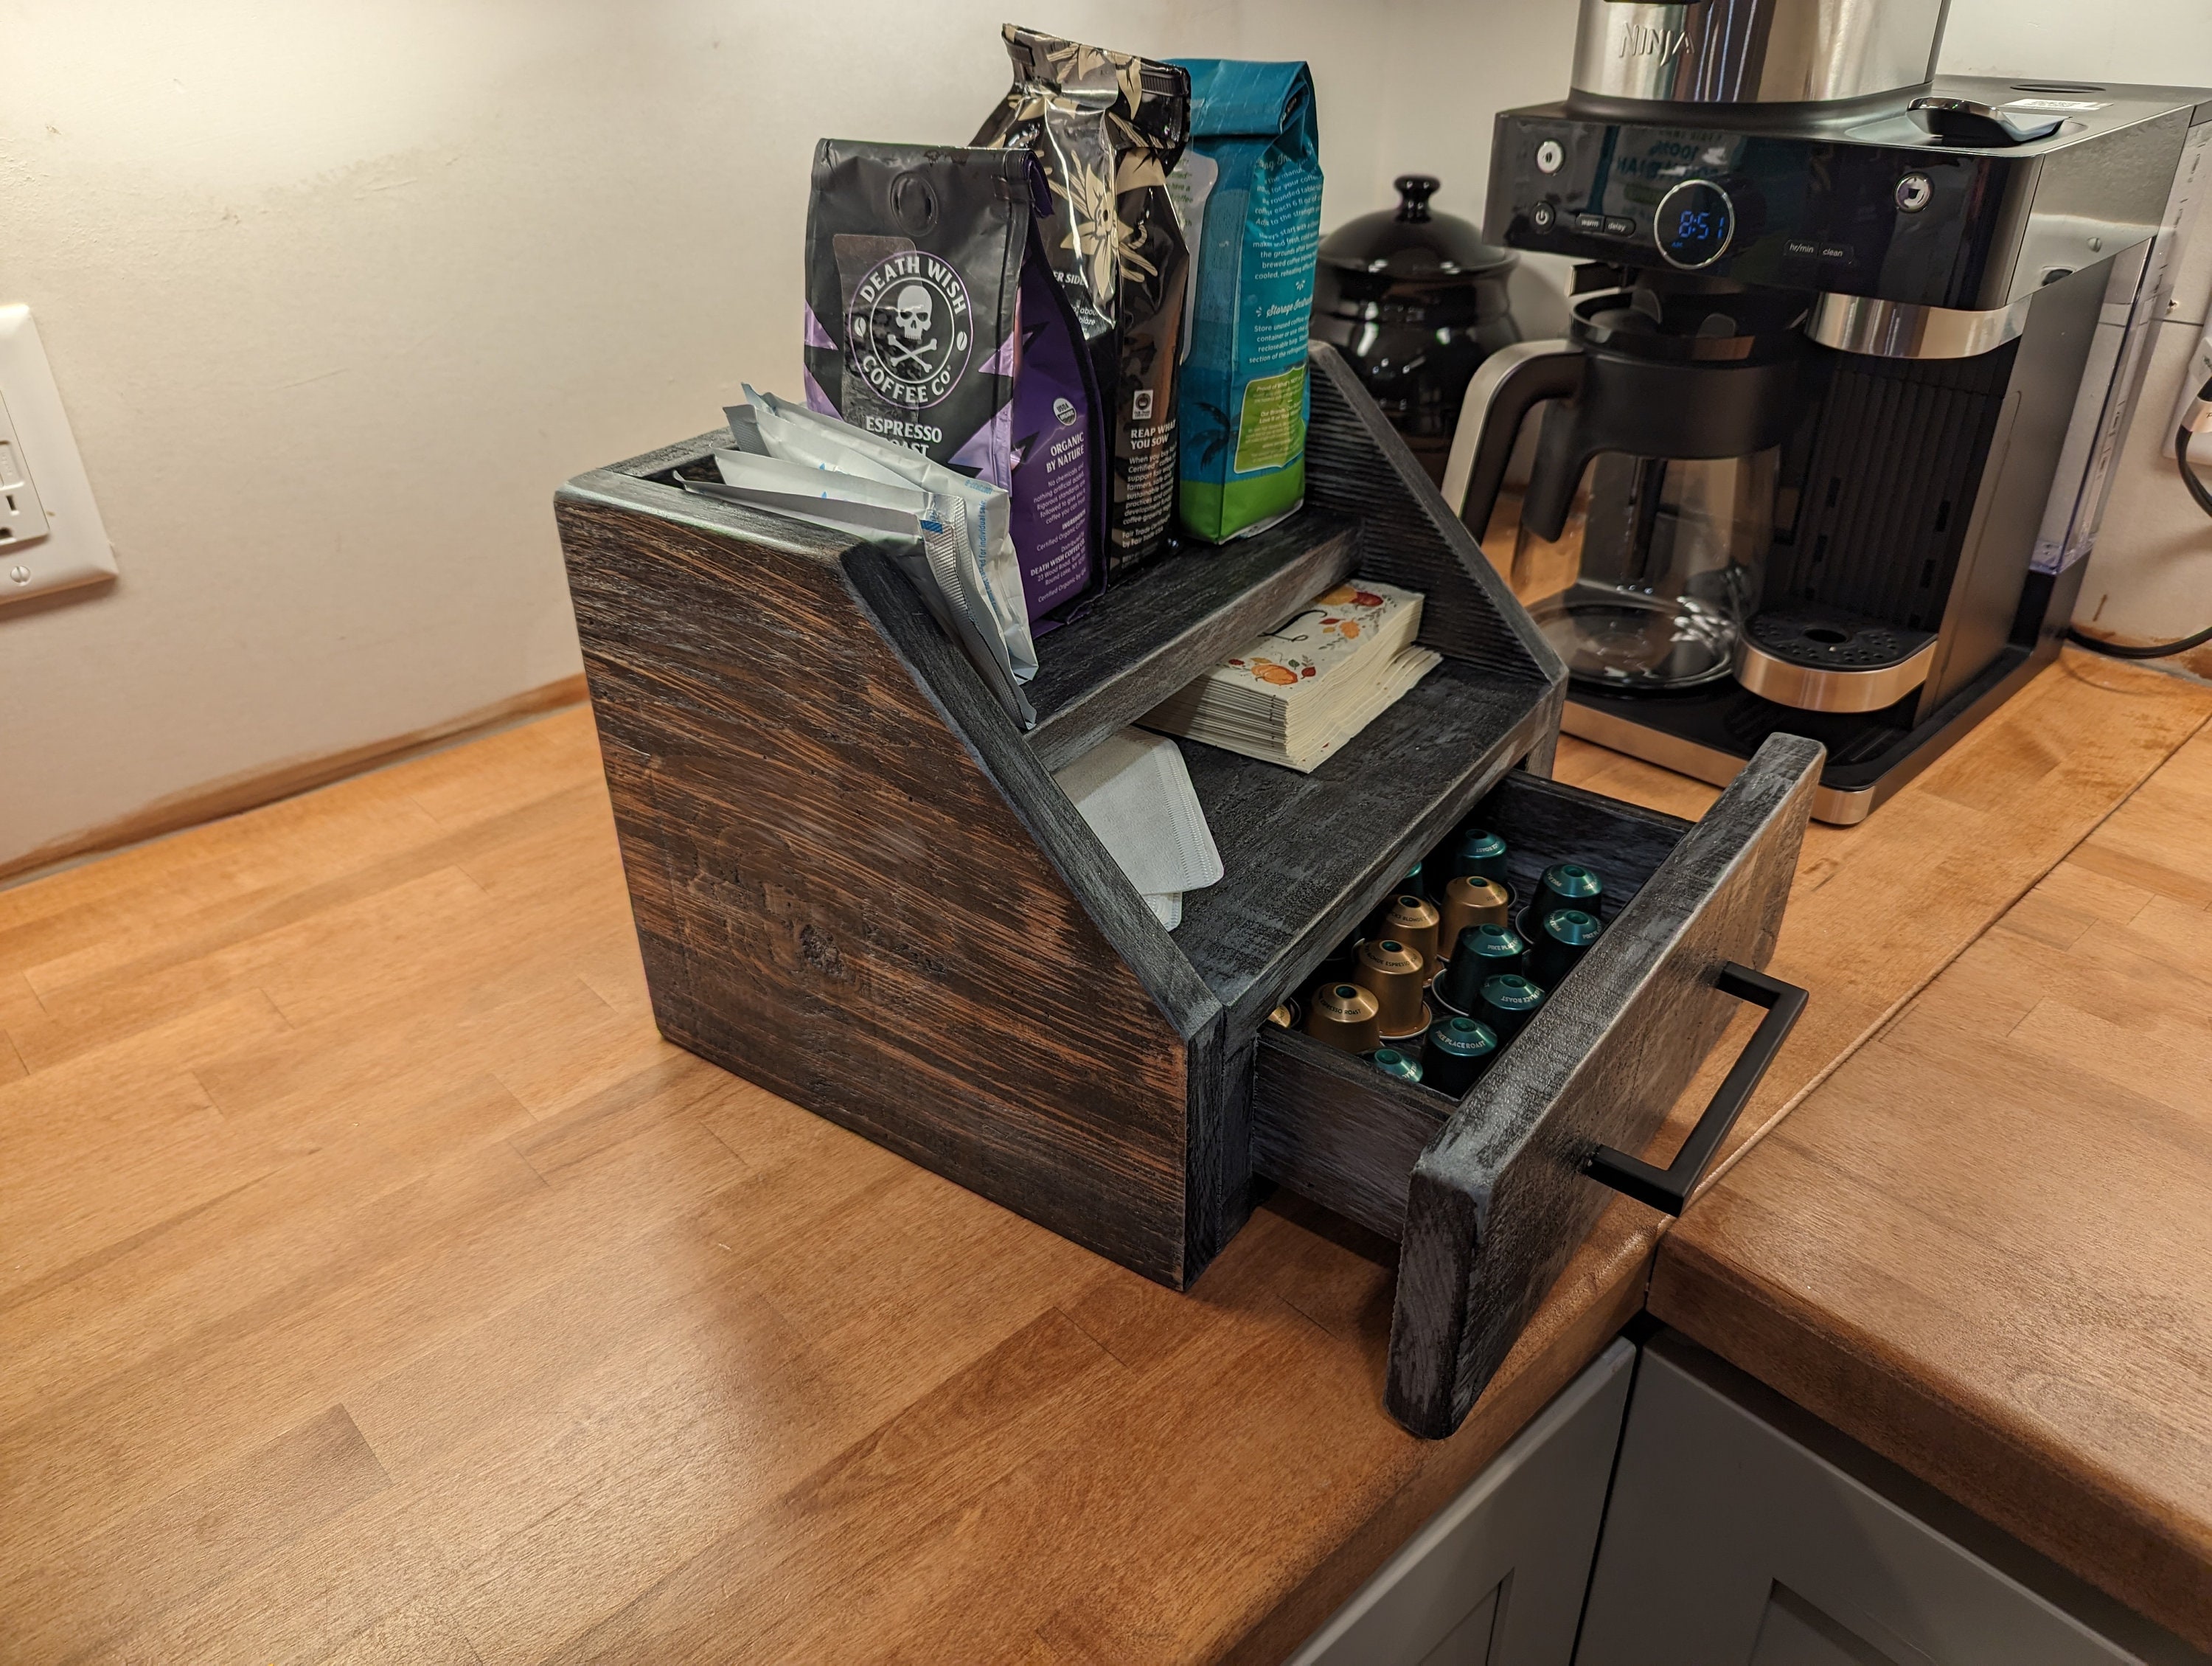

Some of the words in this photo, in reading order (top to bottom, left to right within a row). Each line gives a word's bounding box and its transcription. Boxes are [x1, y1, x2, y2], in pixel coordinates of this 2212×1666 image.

[1618, 21, 1695, 67] NINJA
[1270, 187, 1301, 205] rounded
[1274, 203, 1292, 214] each
[1581, 219, 1599, 227] warm
[1607, 222, 1627, 232] delay
[1678, 210, 1725, 239] 8:51
[1260, 250, 1272, 258] the
[1790, 243, 1814, 254] hr/min
[1823, 247, 1843, 257] clean
[1262, 260, 1286, 269] brewed
[1255, 271, 1279, 280] cooled,
[860, 256, 921, 303] DEATH
[928, 258, 967, 315] WISH
[1266, 302, 1294, 318] Storage
[1256, 332, 1284, 342] container
[1249, 355, 1270, 364] section
[1271, 352, 1279, 360] of
[863, 355, 929, 403] COFFEE
[866, 415, 943, 443] ESPRESSO
[1130, 428, 1155, 439] REAP
[1157, 419, 1176, 434] WHAT
[1051, 431, 1085, 457] ORGANIC
[1130, 440, 1150, 450] YOU
[1151, 433, 1169, 447] SOW
[1046, 459, 1057, 473] BY
[1057, 445, 1085, 468] NATURE
[1129, 456, 1148, 465] When
[1150, 452, 1161, 462] you
[1048, 479, 1056, 487] No
[1056, 468, 1077, 484] chemicals
[1127, 473, 1152, 483] support
[1034, 489, 1053, 504] nothing
[1054, 479, 1072, 494] artificial
[1126, 487, 1159, 500] sustainable
[1040, 503, 1061, 518] followed
[1046, 513, 1061, 524] coffee
[1062, 508, 1070, 518] you
[978, 516, 987, 548] individual
[1122, 530, 1134, 539] Fair
[1037, 535, 1058, 552] Certified
[1122, 541, 1130, 549] by
[1131, 537, 1142, 545] Fair
[978, 548, 987, 559] for
[1030, 561, 1050, 577] DEATH
[1050, 554, 1065, 568] WISH
[1045, 573, 1060, 586] Round
[1038, 587, 1058, 603] Certified
[1500, 996, 1523, 1004] ROAST
[1444, 1038, 1465, 1048] PLACE
[1466, 1040, 1486, 1049] ROAST
